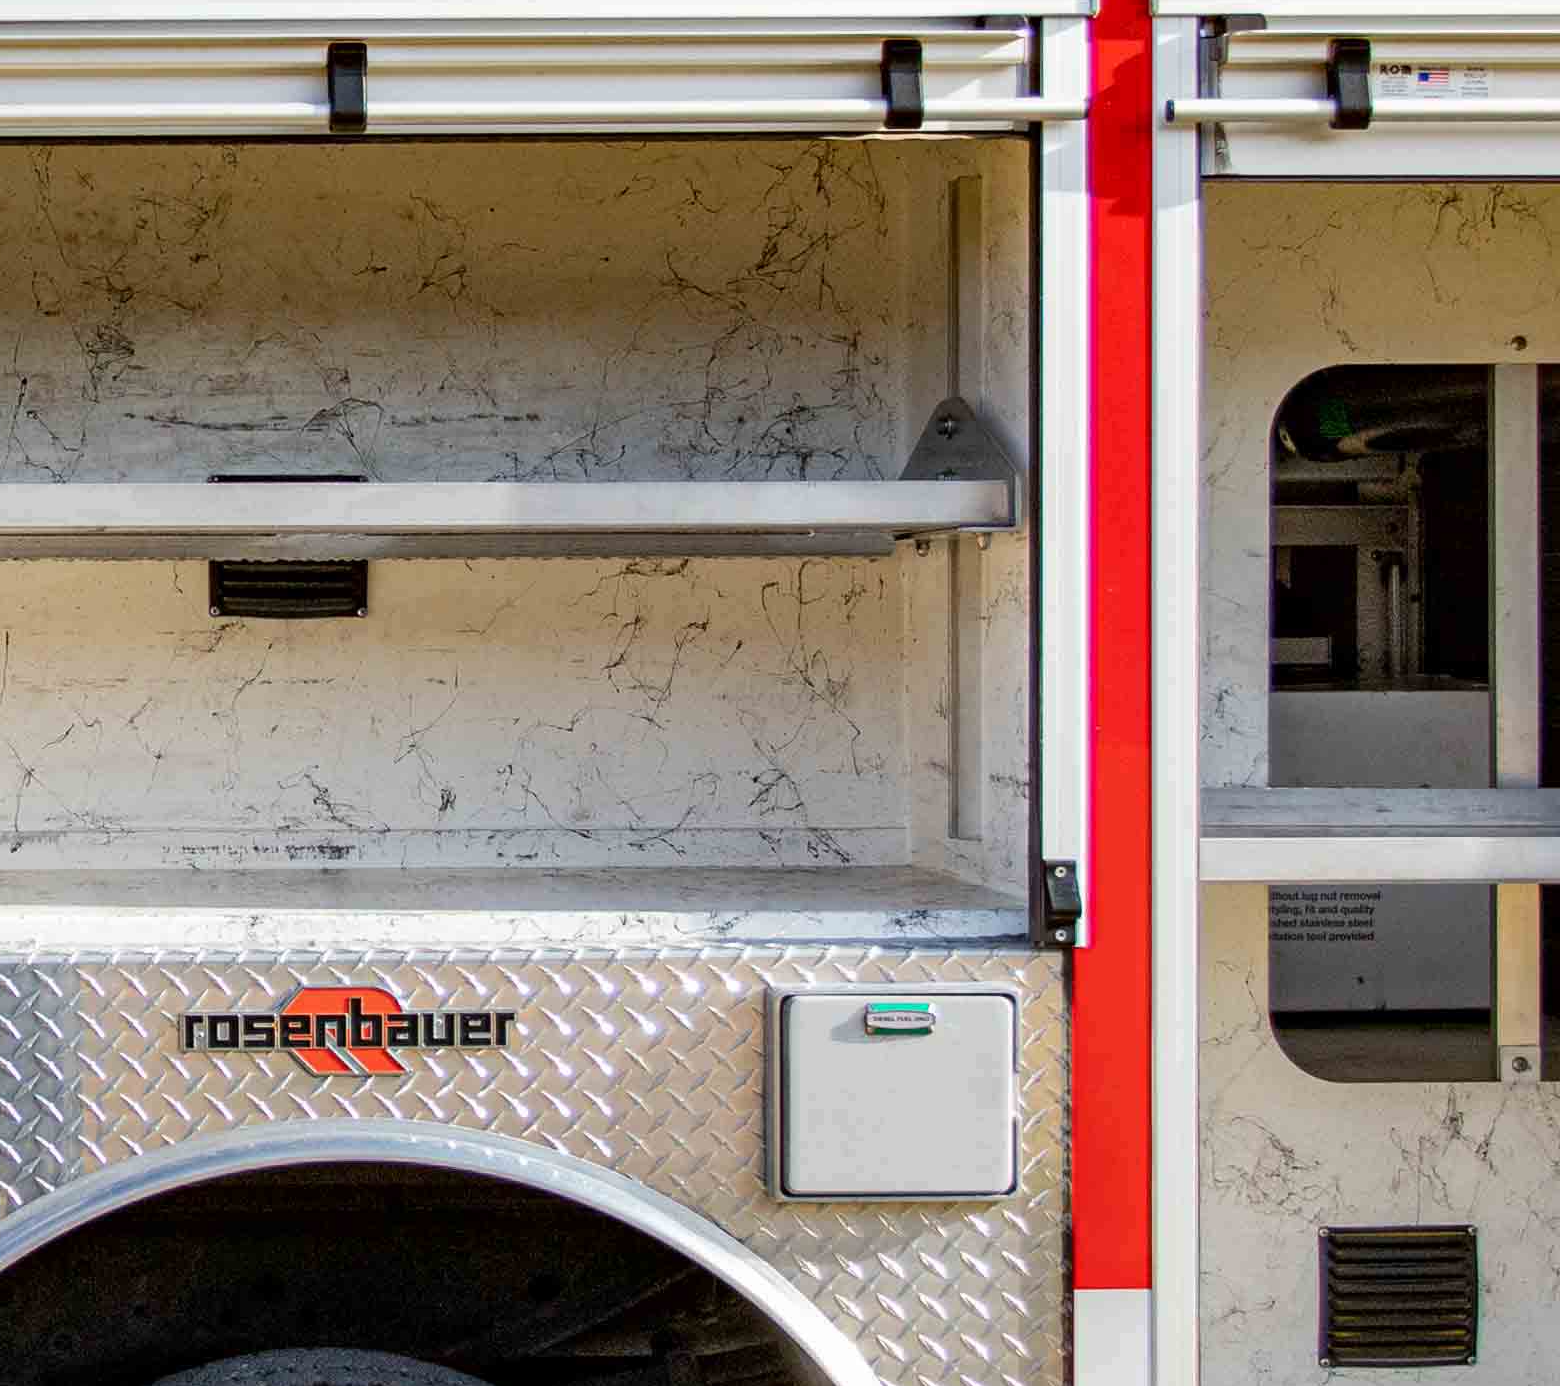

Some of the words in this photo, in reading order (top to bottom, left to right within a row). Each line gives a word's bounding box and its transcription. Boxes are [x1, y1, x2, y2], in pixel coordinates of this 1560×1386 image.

[1320, 892, 1337, 901] nut
[1339, 891, 1381, 901] removal
[1328, 931, 1375, 942] provided
[183, 997, 516, 1049] rosenbauer
